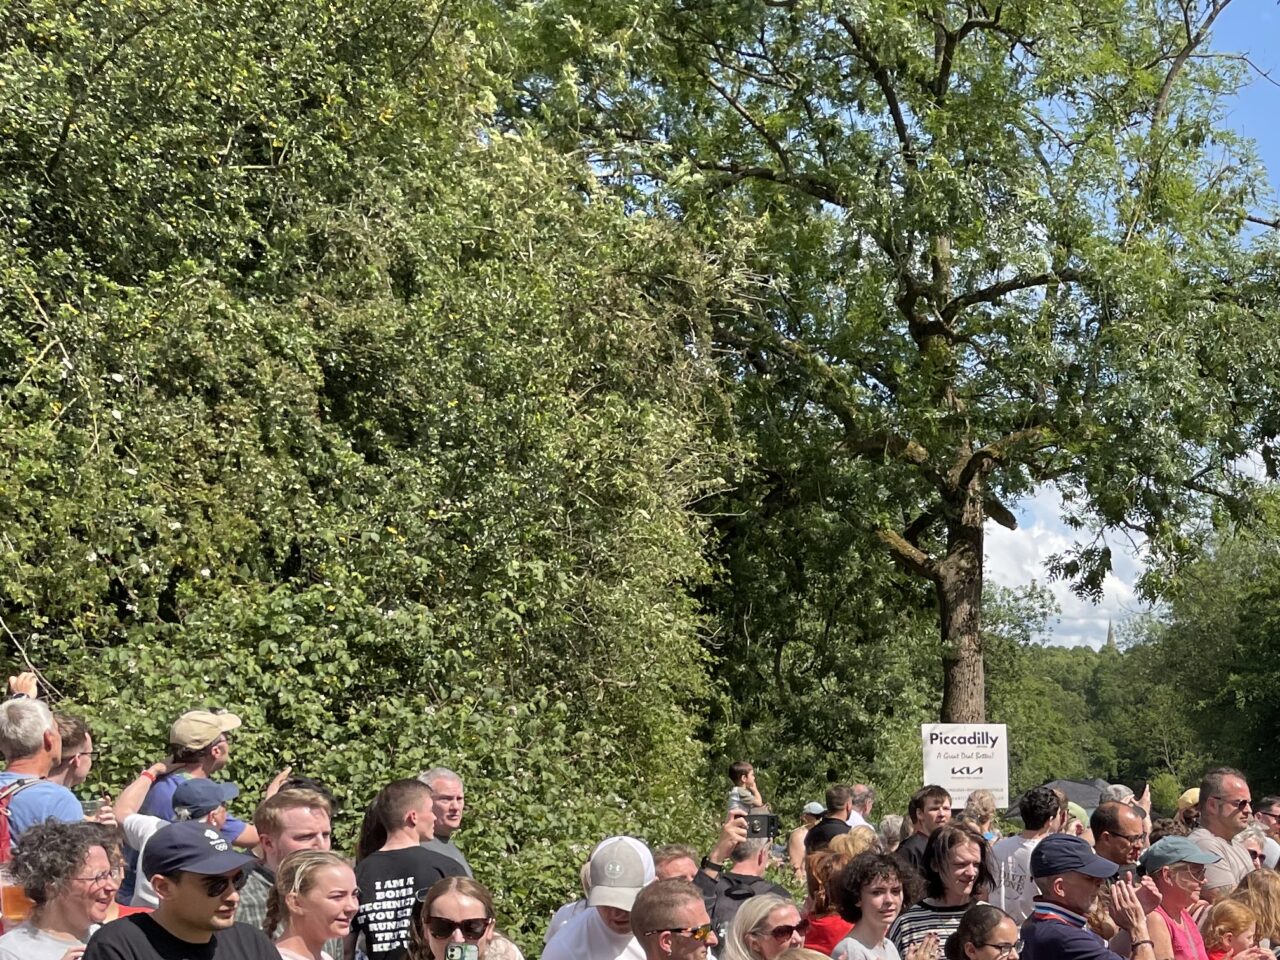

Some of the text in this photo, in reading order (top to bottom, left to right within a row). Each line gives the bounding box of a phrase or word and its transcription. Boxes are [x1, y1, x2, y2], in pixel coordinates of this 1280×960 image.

[929, 731, 998, 748] Piccadilly
[936, 751, 942, 759] A
[951, 766, 984, 775] KIA
[375, 876, 415, 890] I AM A
[367, 910, 395, 921] YOU
